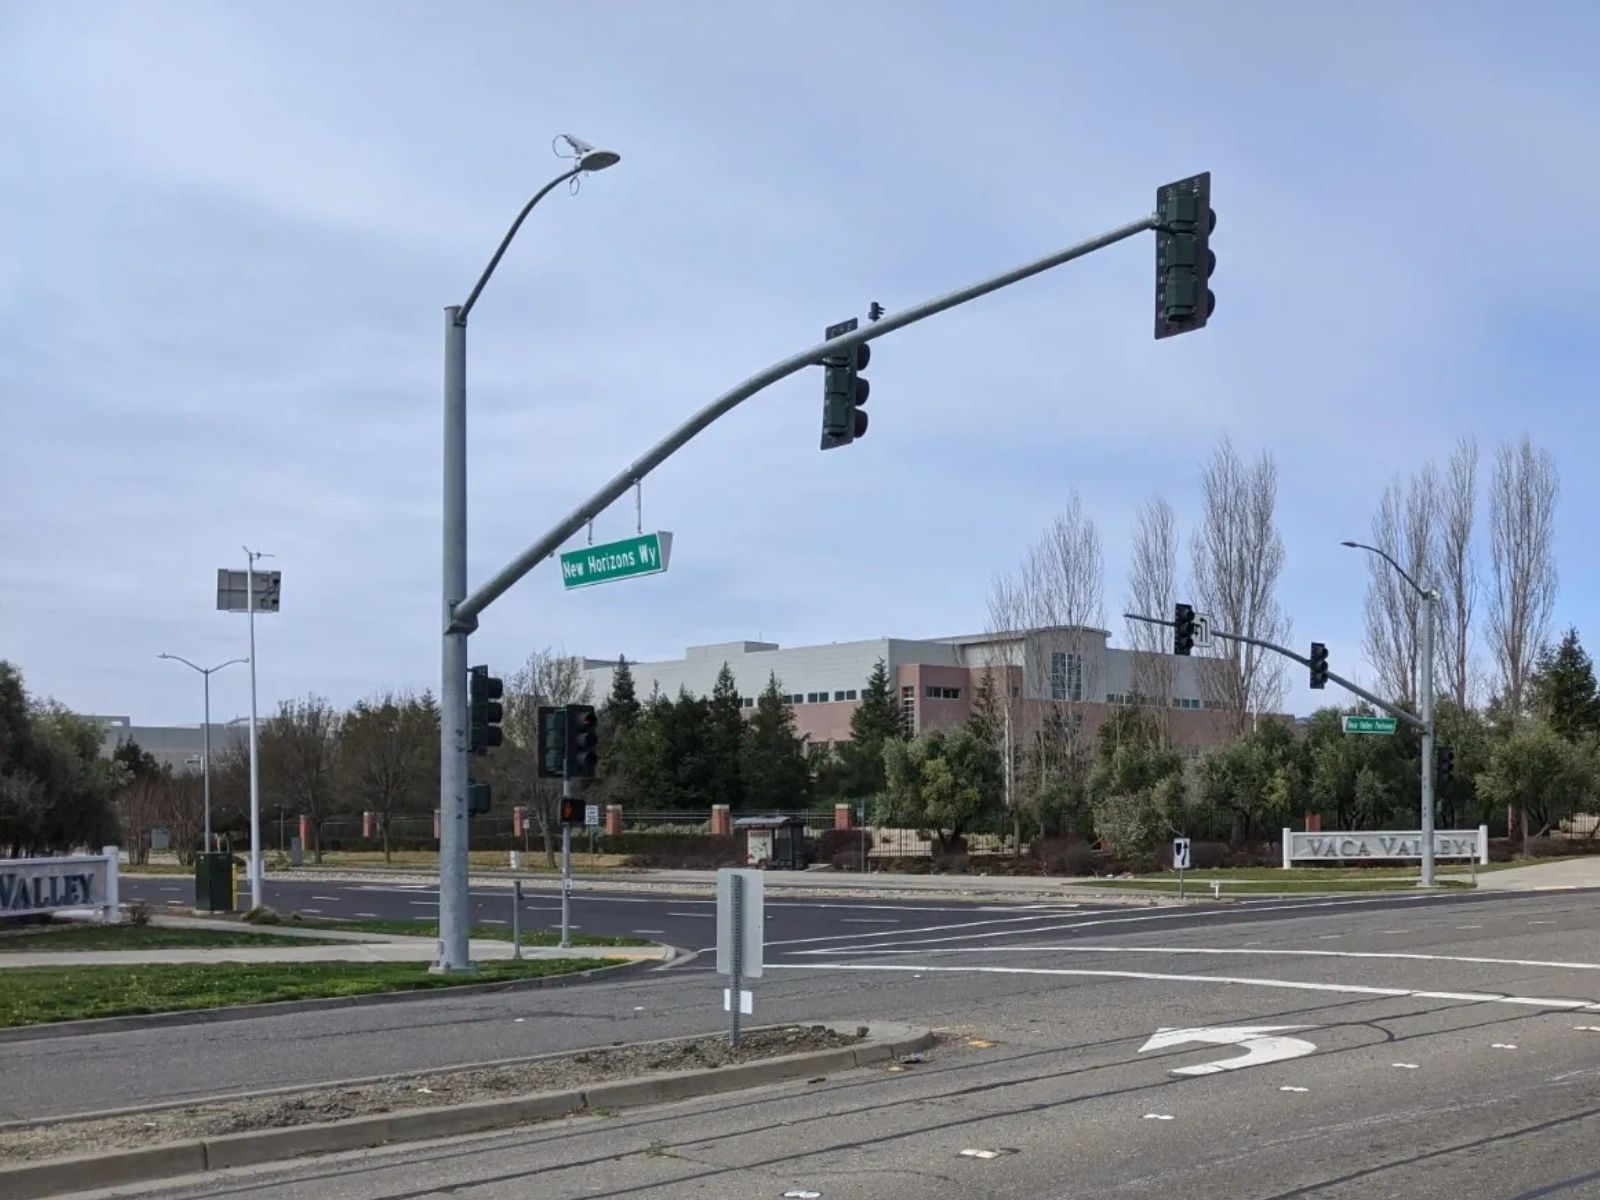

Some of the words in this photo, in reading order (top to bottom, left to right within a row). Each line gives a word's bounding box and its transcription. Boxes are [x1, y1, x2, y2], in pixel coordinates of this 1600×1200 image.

[563, 561, 584, 579] New
[587, 551, 635, 574] Horizons
[638, 544, 656, 567] Wy
[1307, 838, 1370, 857] VACA
[1379, 837, 1467, 856] VALEY
